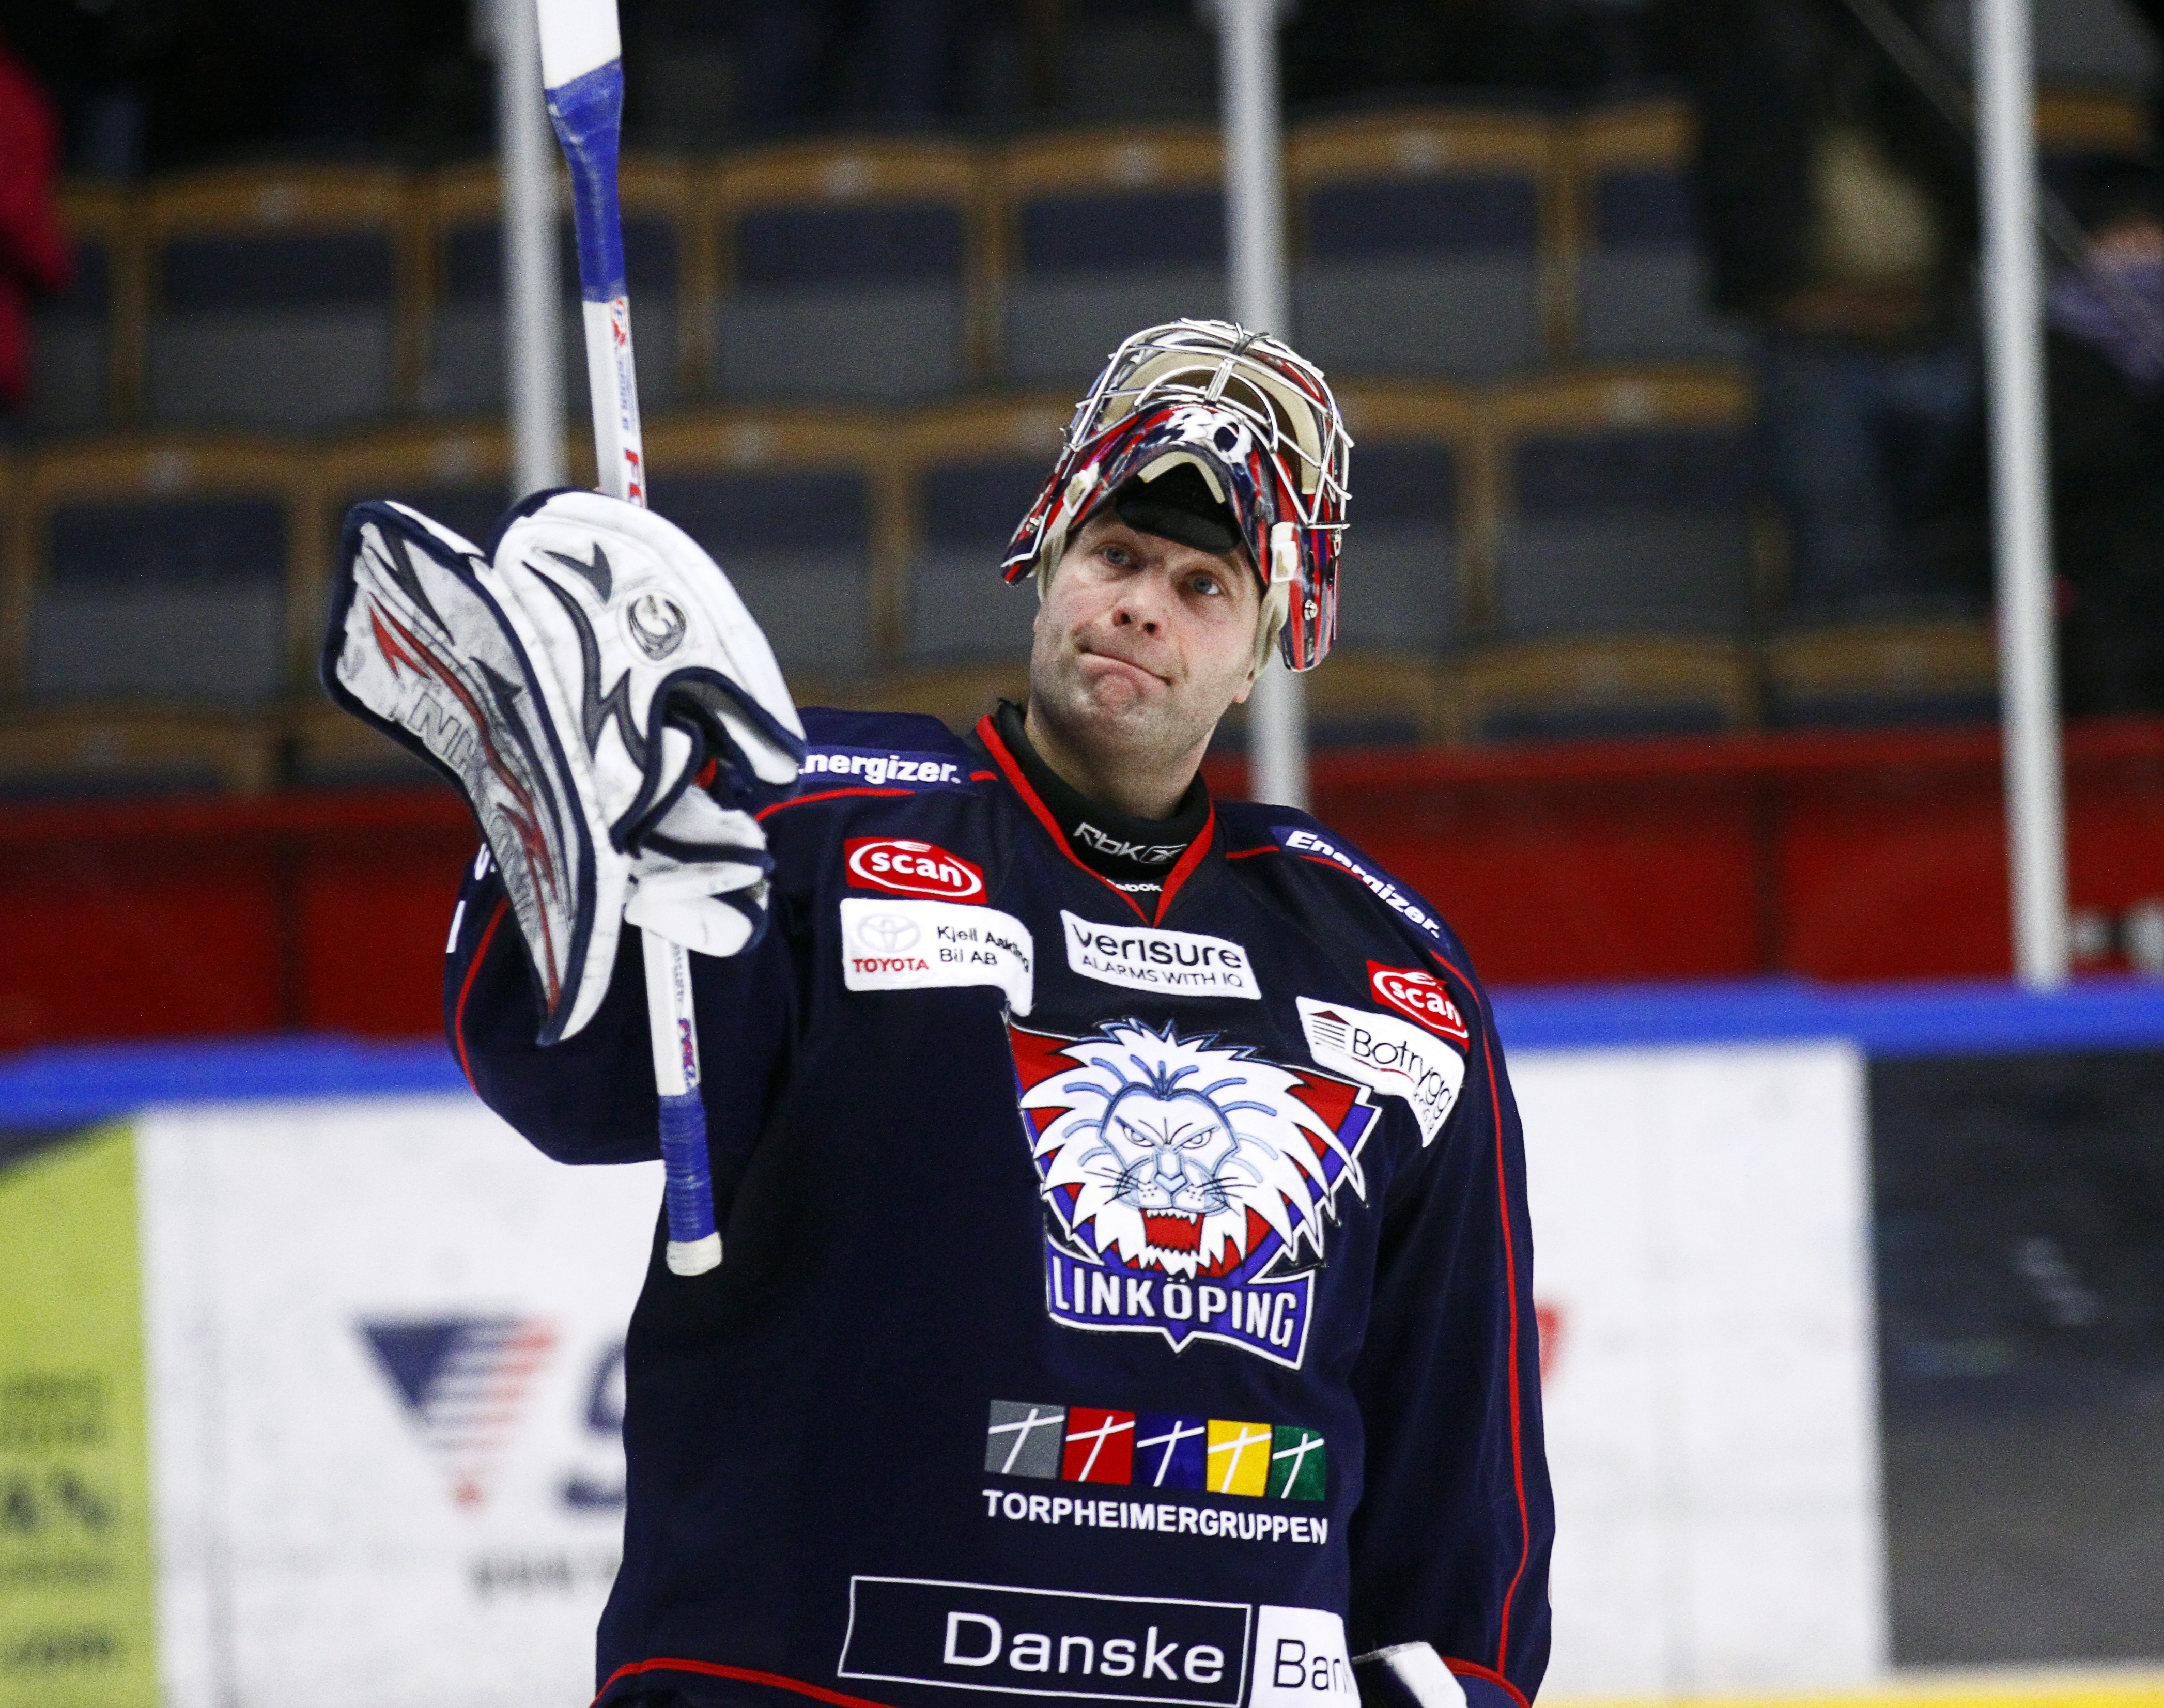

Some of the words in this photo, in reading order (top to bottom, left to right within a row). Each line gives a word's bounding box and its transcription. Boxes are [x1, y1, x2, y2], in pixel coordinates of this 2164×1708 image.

[798, 754, 961, 785] nergizer.
[871, 851, 963, 887] scan
[937, 925, 978, 943] Kjell
[1071, 923, 1242, 968] verisure
[852, 958, 930, 973] TOYOTA
[938, 948, 964, 963] Bil
[970, 951, 998, 966] AB
[1082, 955, 1159, 983] ALARMS
[1162, 970, 1217, 985] WITH
[1222, 972, 1244, 988] IQ
[1389, 981, 1462, 1028] scan
[1353, 1028, 1453, 1121] Botrygg
[1052, 1255, 1297, 1349] LINKÖPING
[982, 1489, 1328, 1545] TORPHEIMERGRUPPEN
[943, 1611, 1225, 1684] Danske
